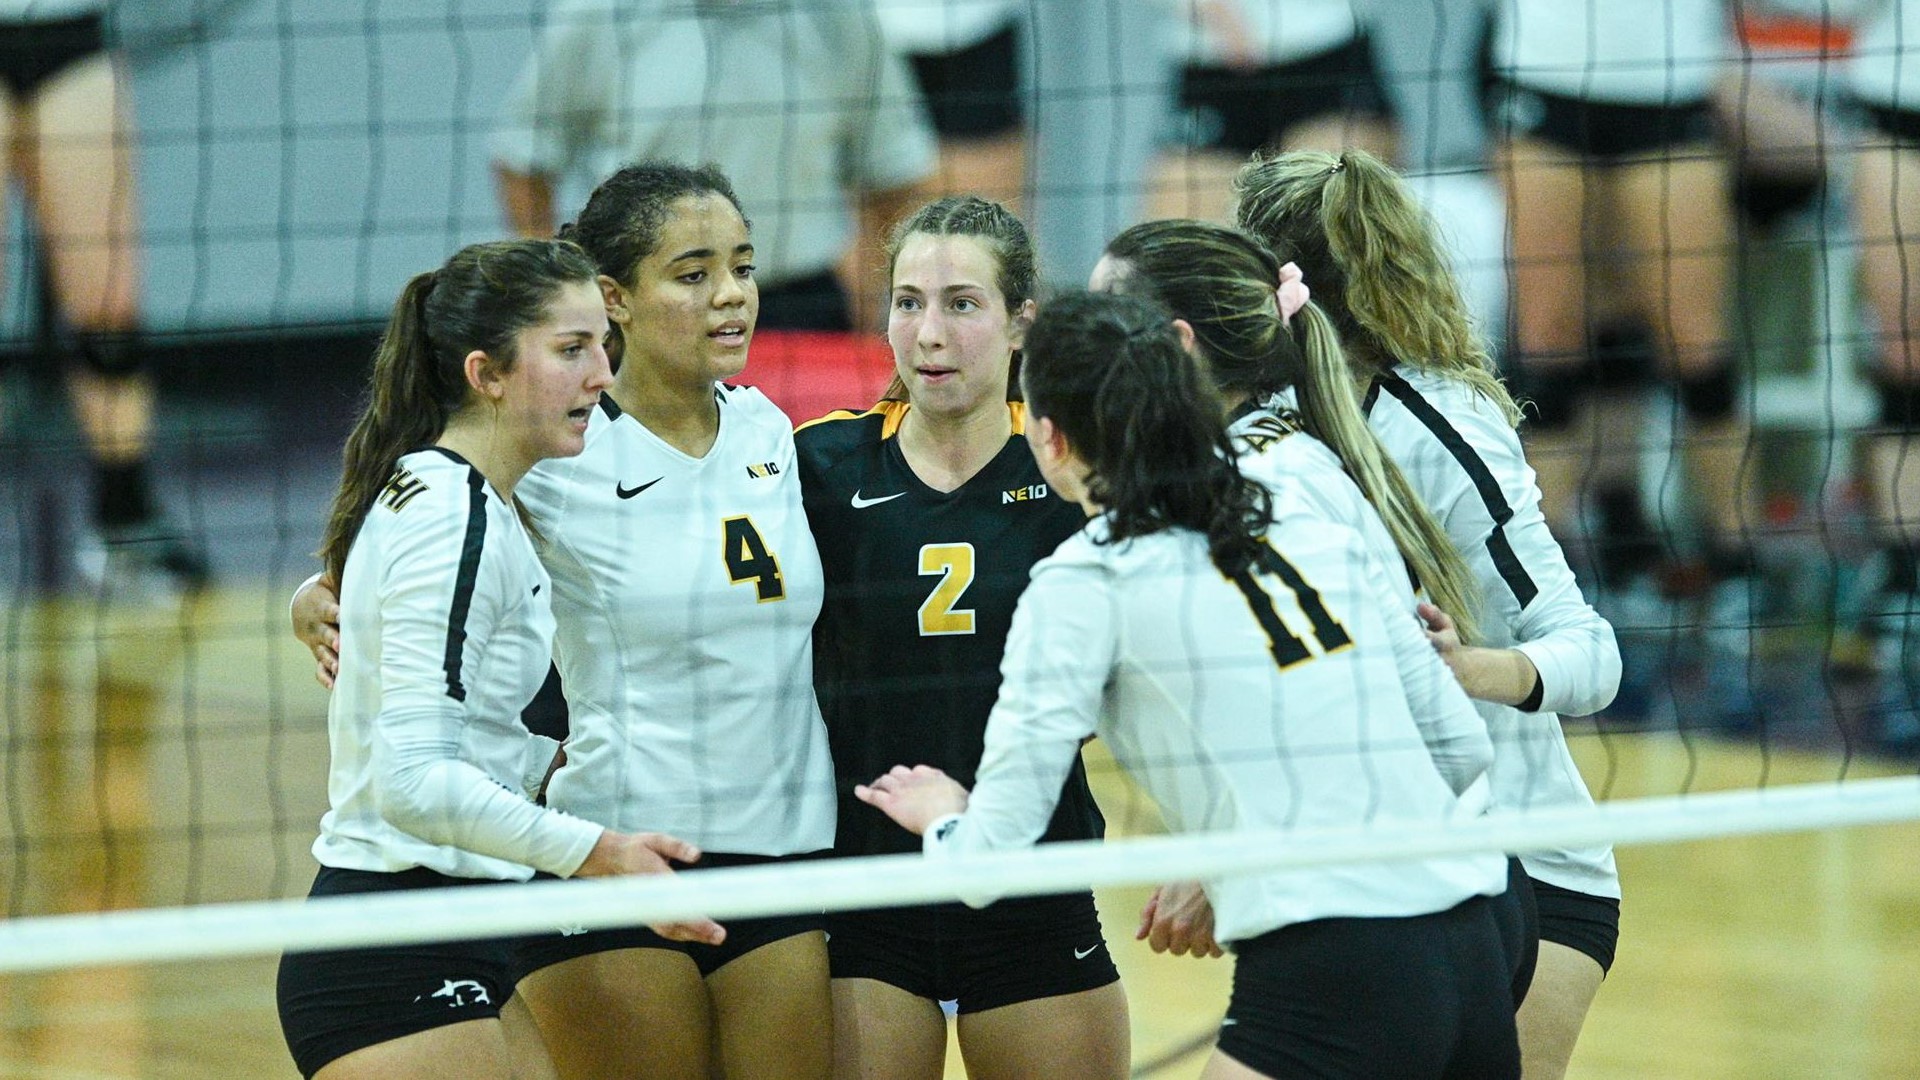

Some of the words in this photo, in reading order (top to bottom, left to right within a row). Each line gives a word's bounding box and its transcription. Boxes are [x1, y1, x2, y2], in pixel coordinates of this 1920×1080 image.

[746, 462, 780, 479] NE10
[1002, 484, 1048, 504] NE10
[722, 514, 786, 603] 4
[918, 542, 976, 636] 2
[1209, 533, 1357, 673] 11
